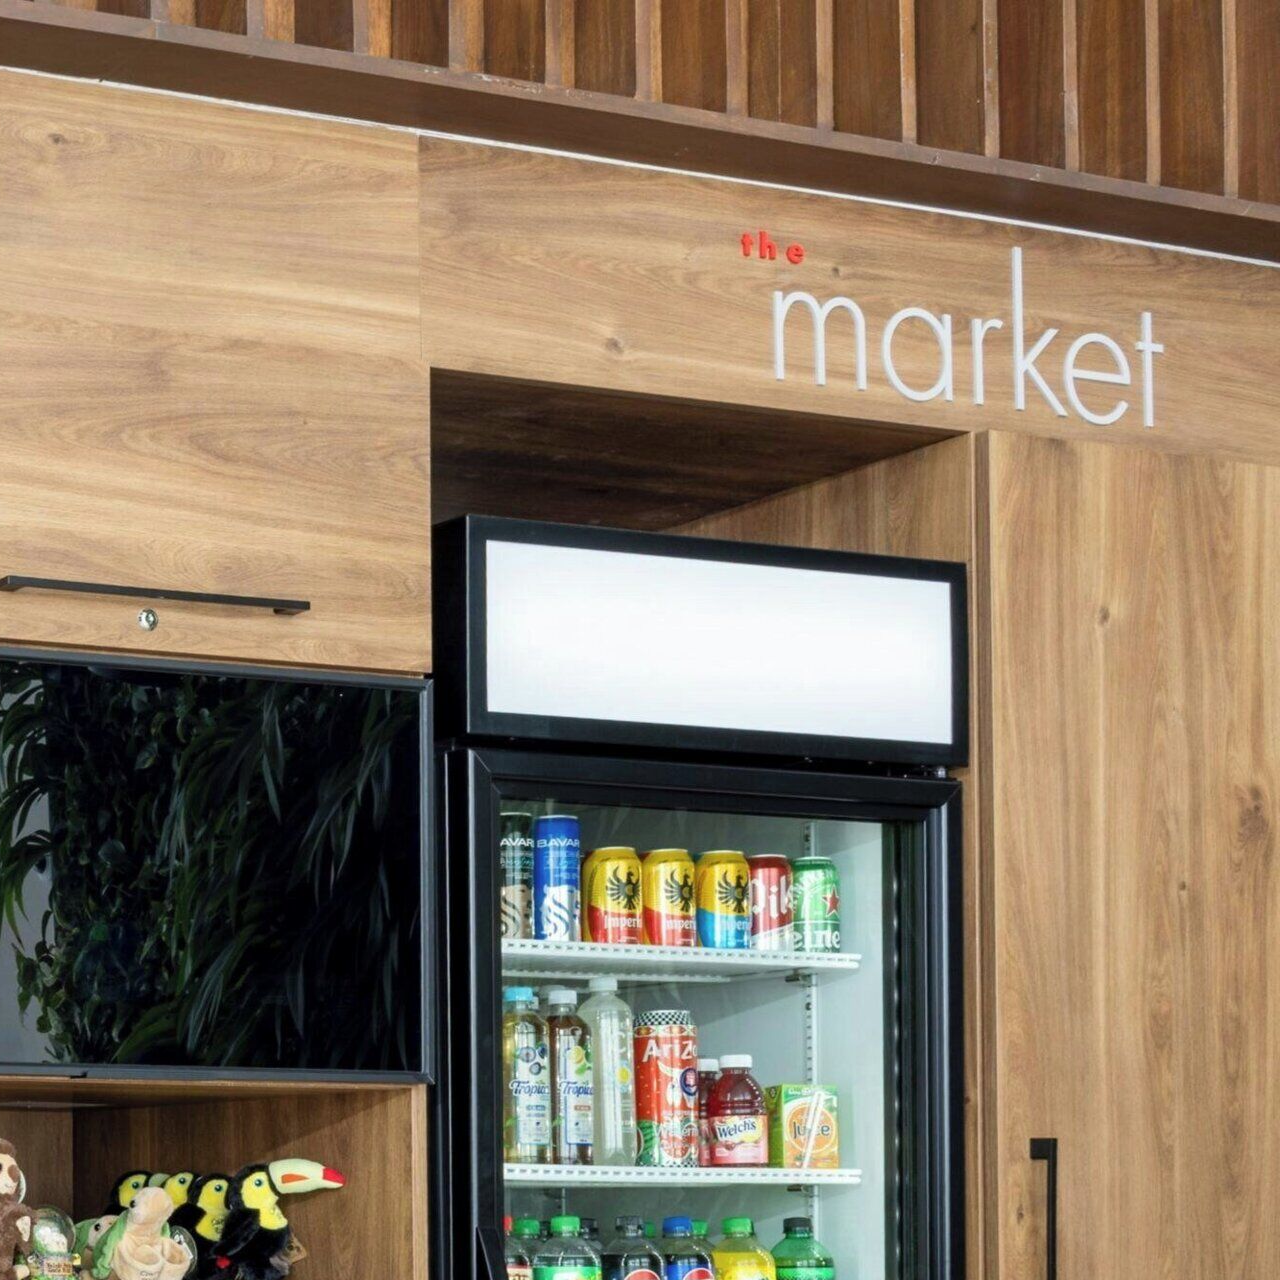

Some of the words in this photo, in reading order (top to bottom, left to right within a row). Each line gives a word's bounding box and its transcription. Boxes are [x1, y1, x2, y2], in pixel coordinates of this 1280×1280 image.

[741, 231, 805, 264] the
[773, 246, 1164, 427] market
[717, 1119, 757, 1139] Welch's
[793, 1120, 830, 1138] Juce
